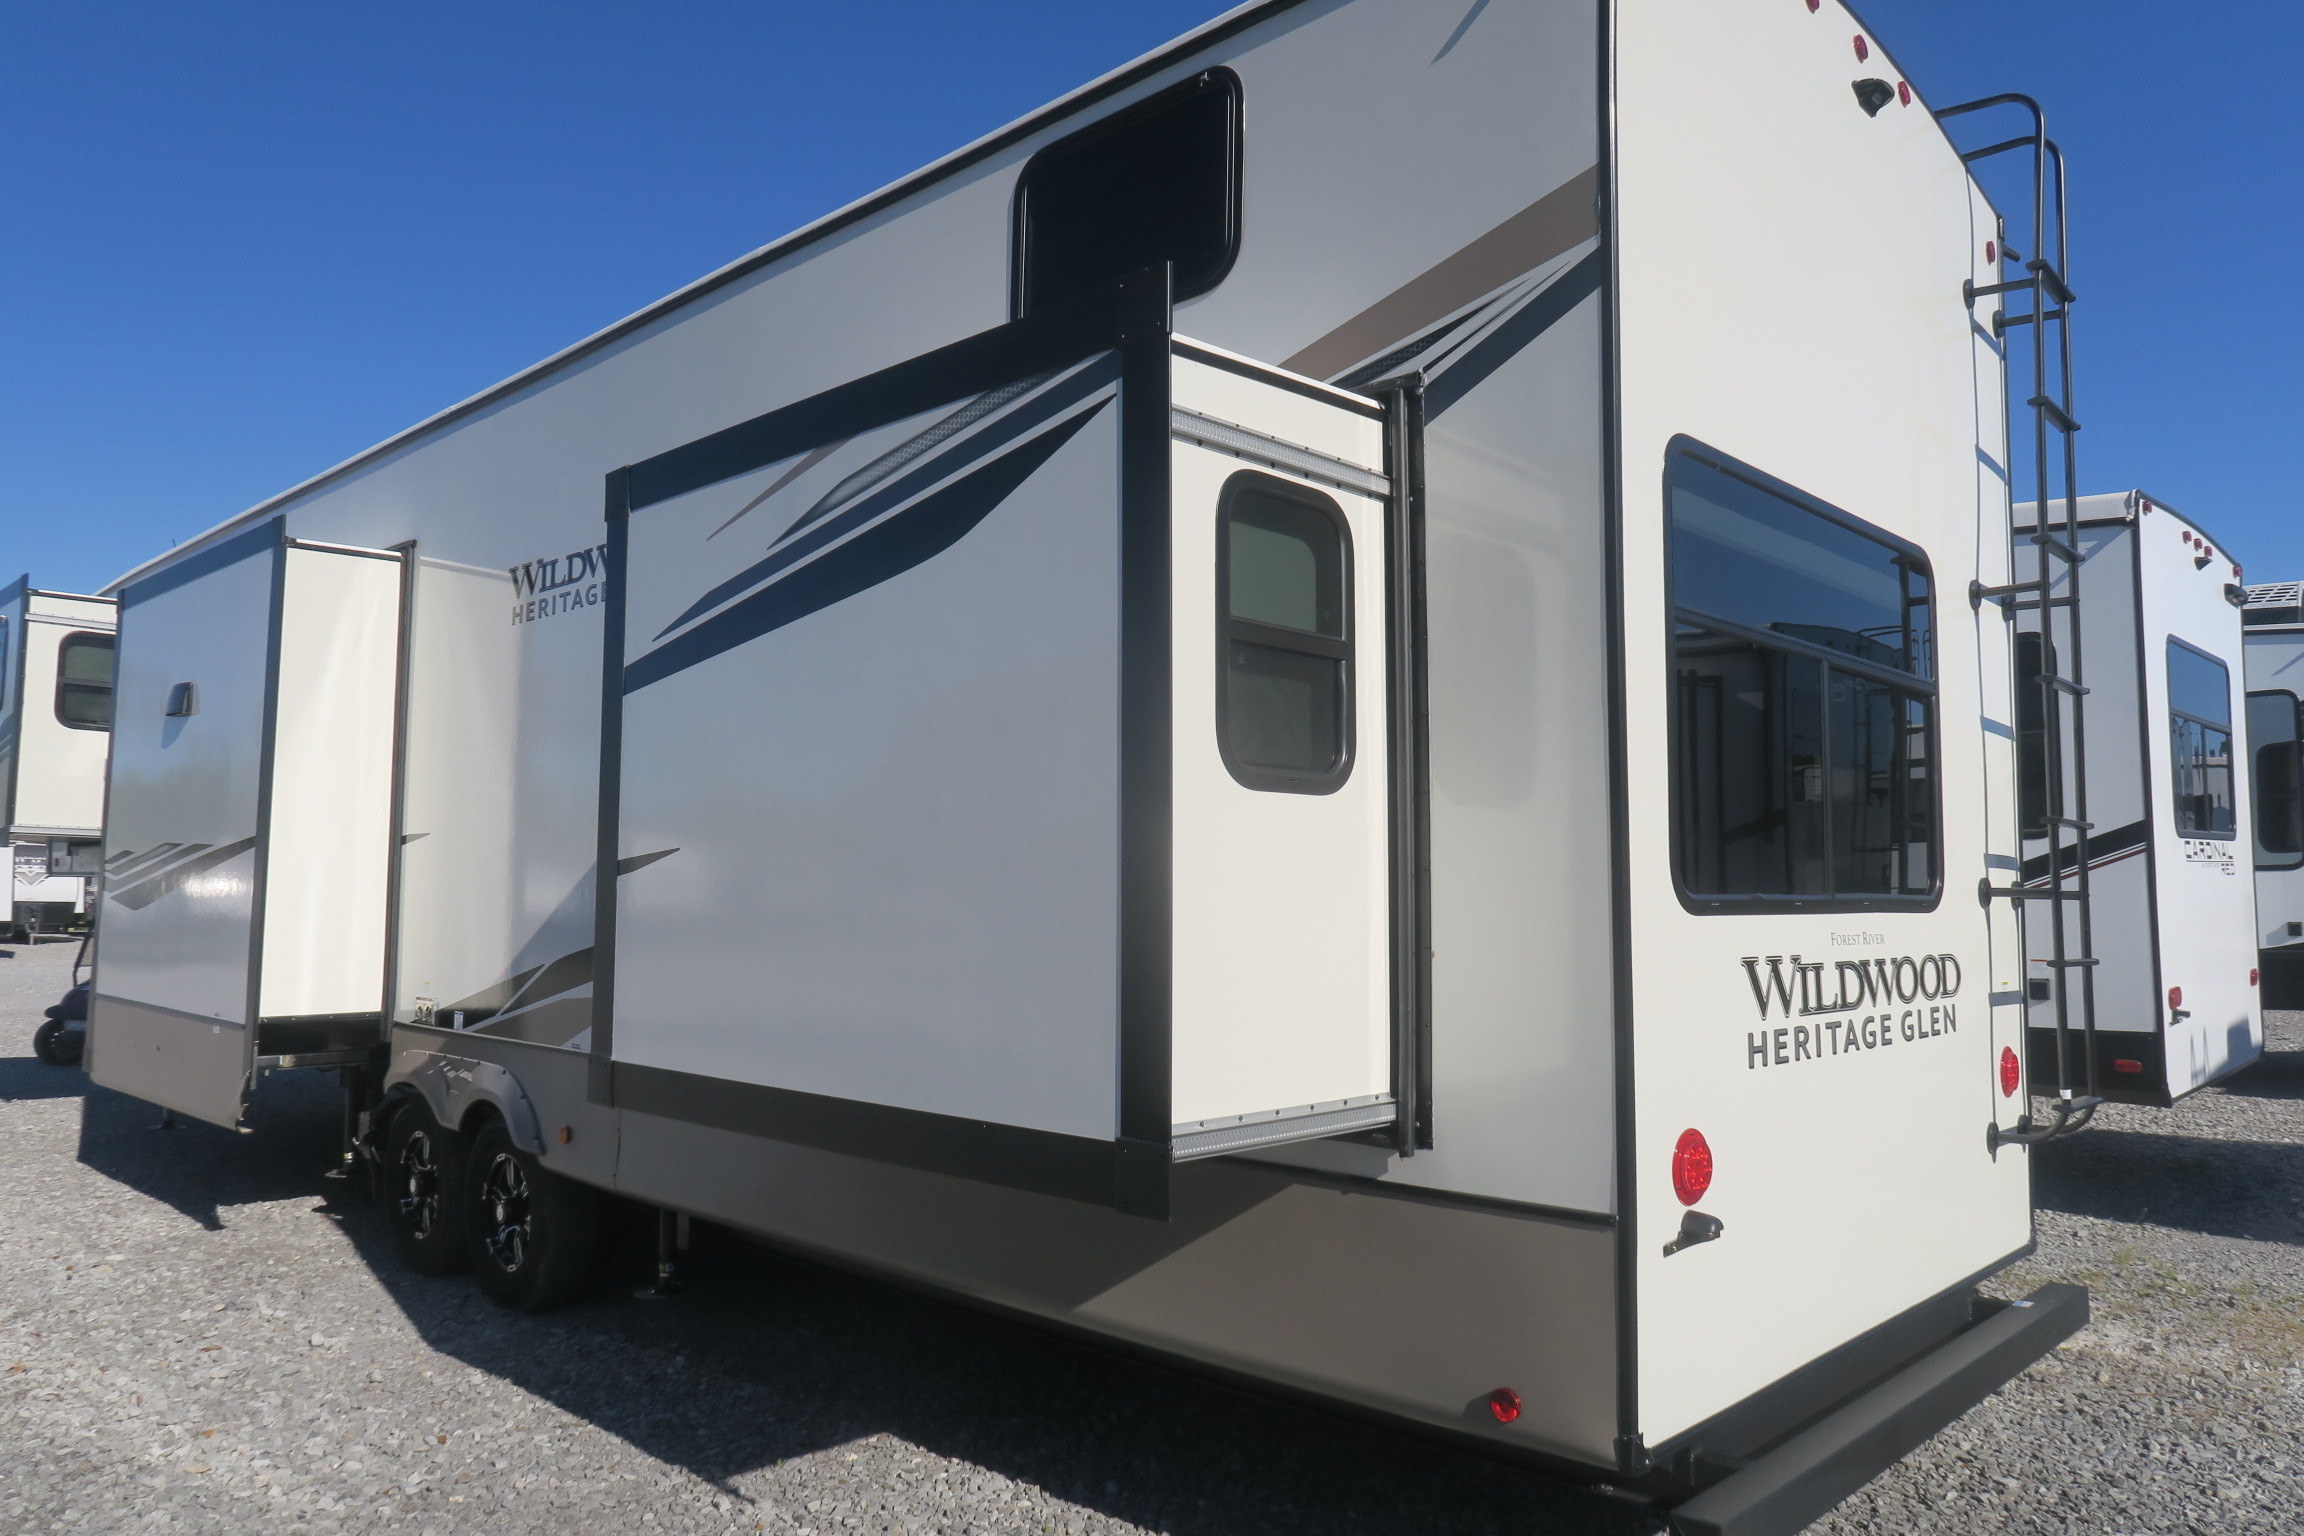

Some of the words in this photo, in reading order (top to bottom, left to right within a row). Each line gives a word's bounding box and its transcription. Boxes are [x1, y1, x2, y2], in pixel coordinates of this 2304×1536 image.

[508, 543, 607, 599] WILDW
[2184, 840, 2234, 860] CARDINAL
[1830, 932, 1861, 946] FOREST
[1862, 931, 1885, 945] RIVER
[1740, 954, 1961, 1021] WILDWOOD
[1747, 1013, 1893, 1070] HERITAGE
[1900, 1003, 1957, 1042] GLEN
